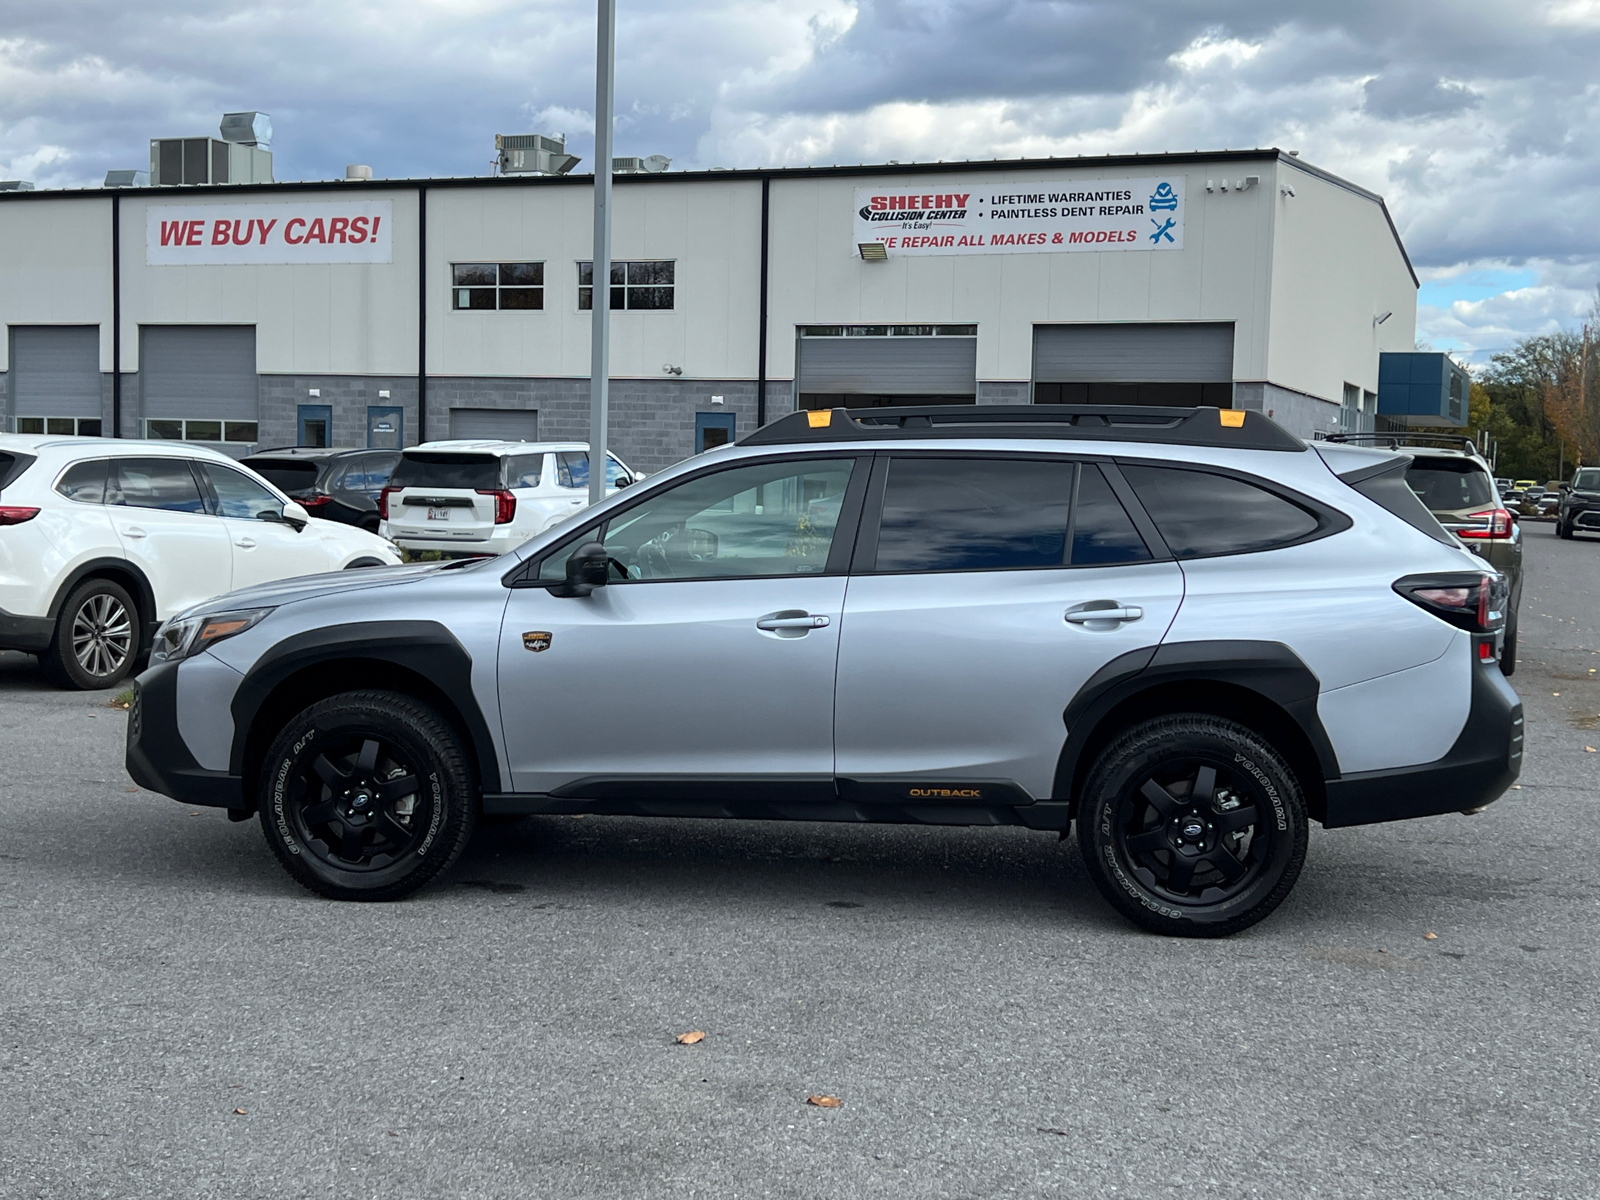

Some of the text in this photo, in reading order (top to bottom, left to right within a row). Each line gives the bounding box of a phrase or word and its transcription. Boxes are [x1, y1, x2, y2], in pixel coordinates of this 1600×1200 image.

[870, 193, 971, 211] SHEEHY
[991, 190, 1132, 205] LIFETIME WARRANTIES
[870, 209, 968, 222] COLLISION CENTER
[991, 204, 1144, 219] PAINTLESS DENT REPAIR
[160, 216, 382, 247] WE BUY CARS!
[902, 221, 933, 231] It's Easy!
[875, 230, 1137, 248] E REPAIR ALL MAKES & MODELS
[273, 728, 316, 855] GEOLANDAR A/T
[909, 788, 980, 797] OUTBACK
[1233, 753, 1287, 831] YOKOHAMA
[1102, 802, 1182, 920] GEOLANDAR A/T
